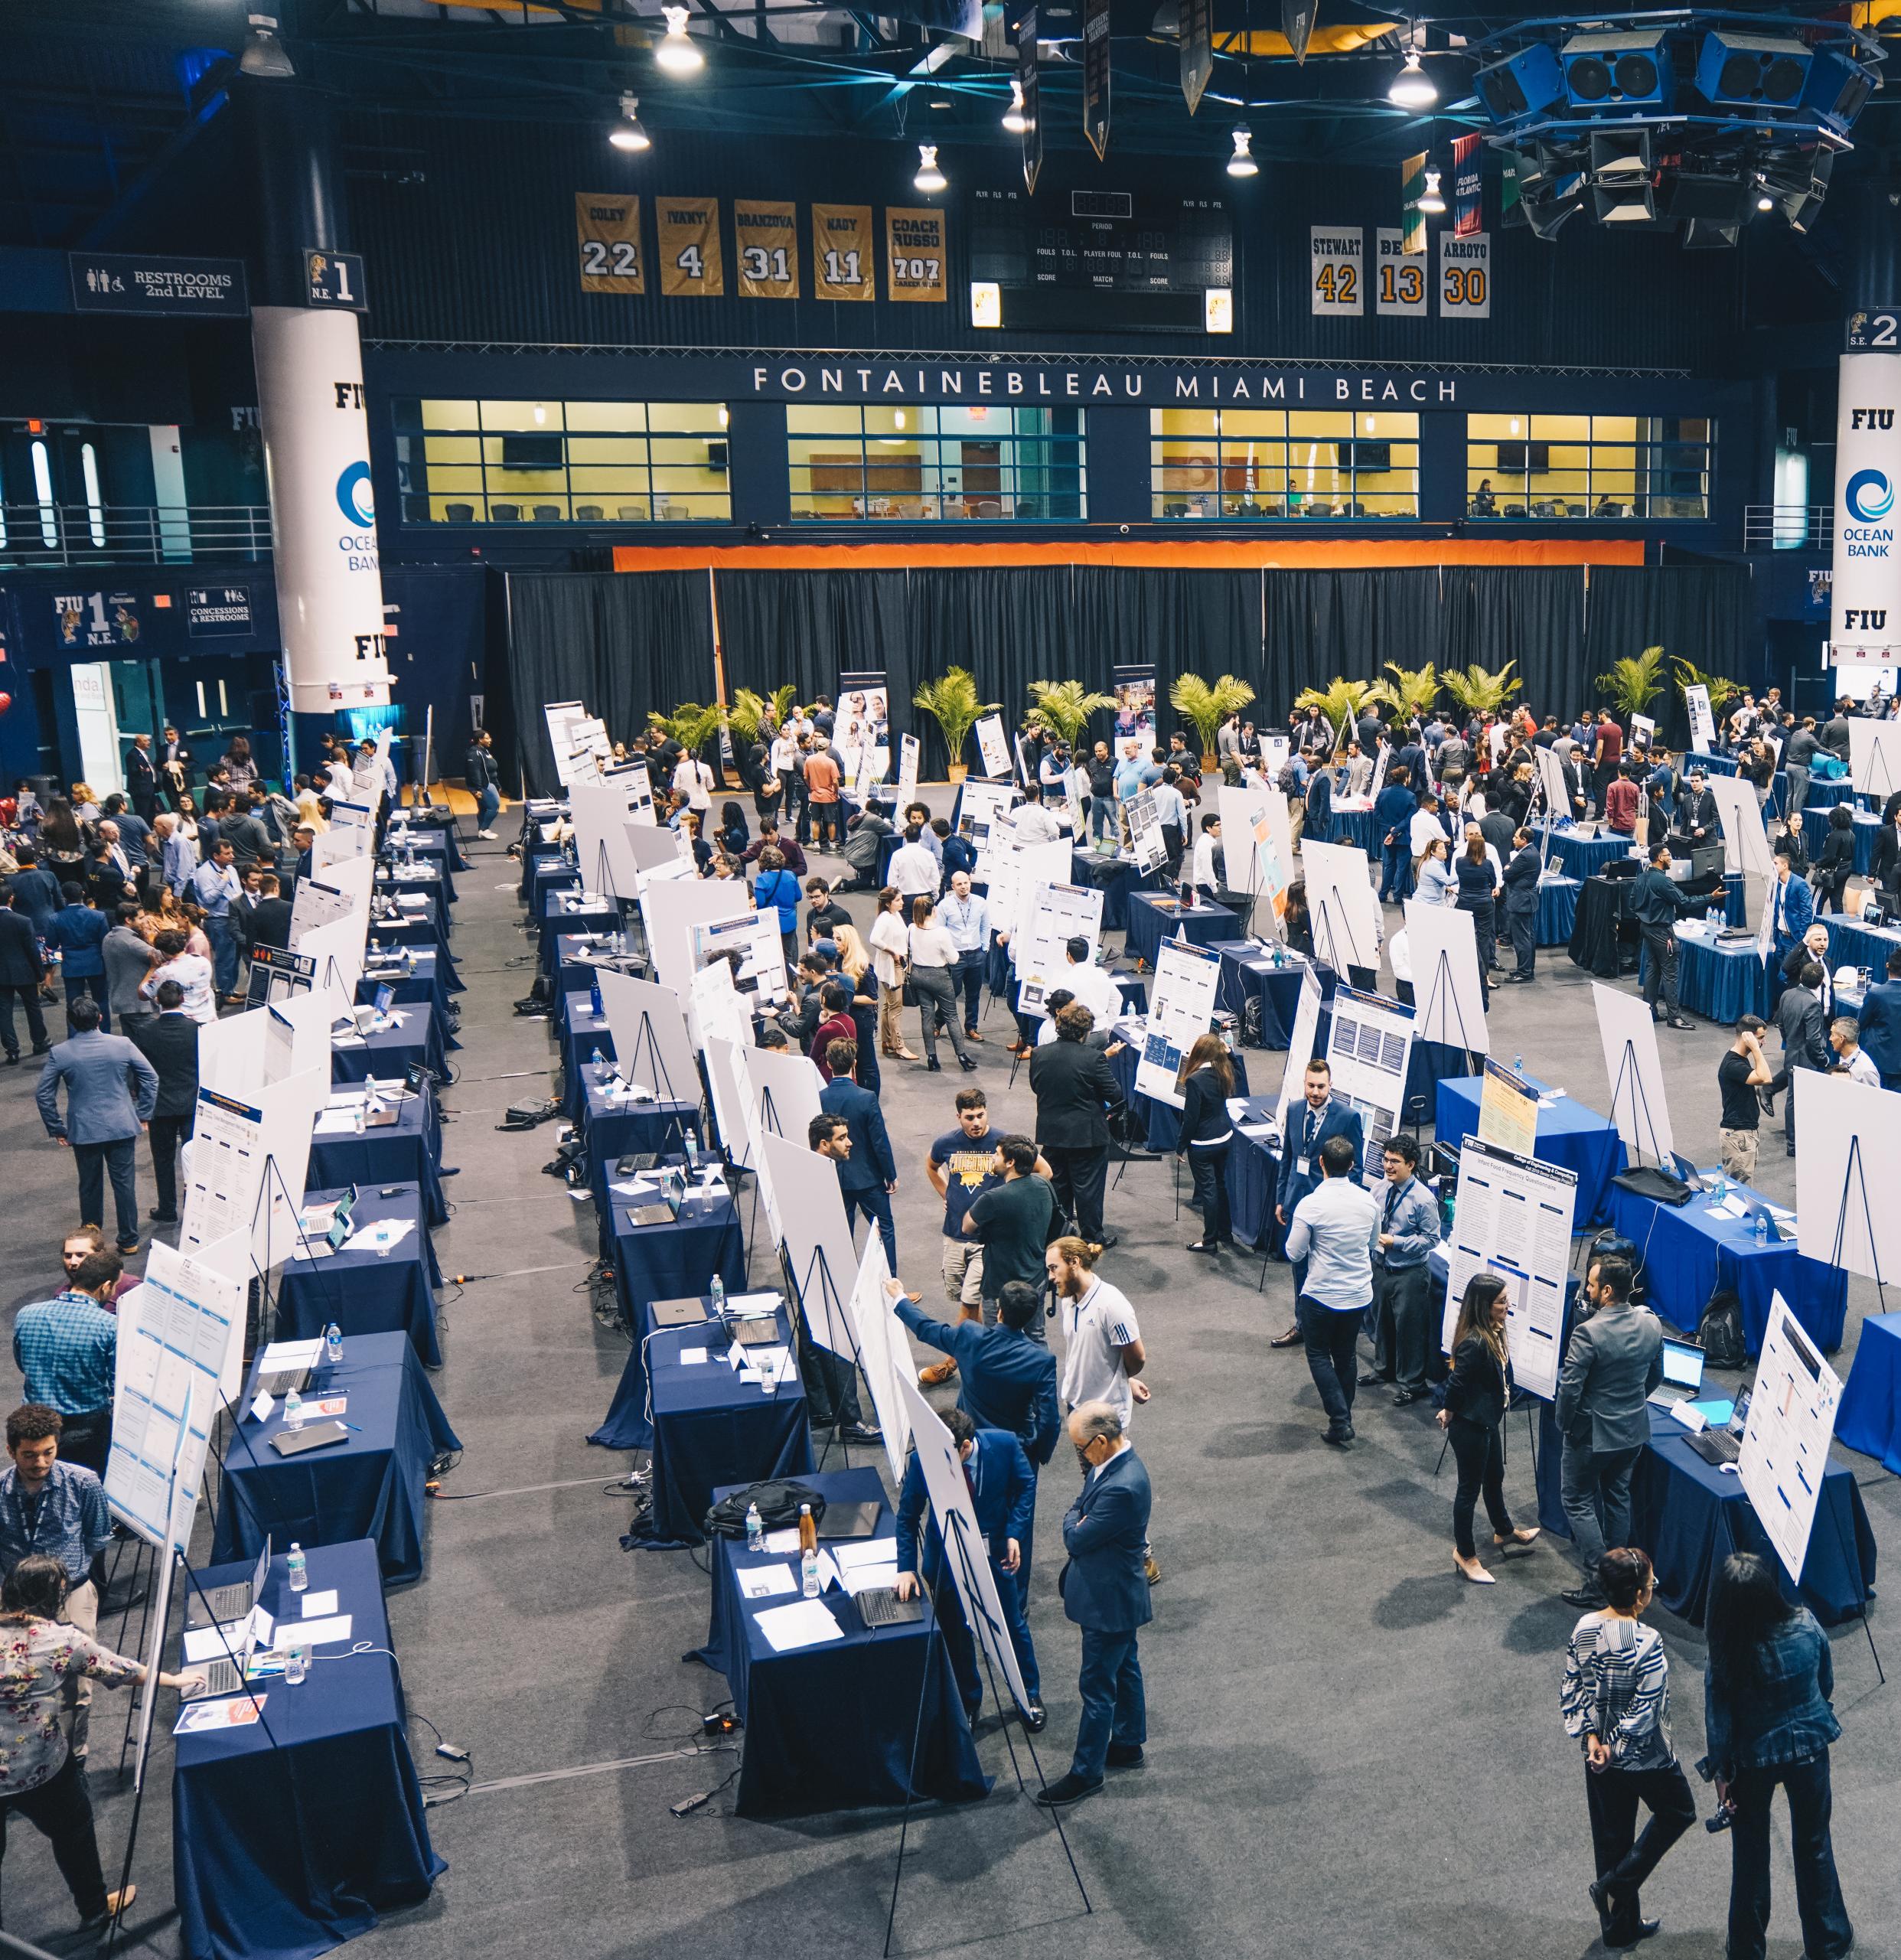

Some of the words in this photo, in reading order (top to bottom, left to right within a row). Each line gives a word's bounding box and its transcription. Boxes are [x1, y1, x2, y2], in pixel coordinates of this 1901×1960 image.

[1457, 173, 1479, 186] FLORIDA
[976, 191, 988, 199] PLYR
[1456, 182, 1482, 196] ATLANTIC
[590, 207, 625, 222] COLEY
[737, 214, 794, 229] BRANZOVA
[827, 218, 858, 231] NAGY
[892, 219, 939, 233] COACH
[892, 233, 940, 248] RUSSO
[1313, 238, 1361, 256] STEWART
[582, 240, 639, 278] 22
[1443, 243, 1486, 259] ARROYO
[677, 244, 705, 279] 4
[743, 246, 791, 282] 31
[824, 249, 862, 285] 11
[894, 257, 941, 280] 707
[134, 271, 232, 287] RESTROOMS
[333, 261, 354, 301] 1
[1316, 263, 1357, 304] 42
[1381, 264, 1424, 305] 13
[1444, 266, 1486, 306] 30
[145, 284, 174, 298] 2nd
[178, 285, 224, 299] LEVEL
[311, 287, 331, 300] N.E.
[1871, 315, 1898, 347] 2
[1850, 336, 1867, 347] S.E.
[754, 367, 1142, 396] FONTAINEBLEAU
[1175, 376, 1303, 399] MIAMI
[1335, 378, 1456, 402] BEACH
[1851, 408, 1895, 431] FIU
[1844, 528, 1893, 542] OCEAN
[339, 536, 378, 552] OCEA
[1847, 544, 1889, 557] BANK
[54, 595, 84, 615] FIU
[88, 592, 109, 632] 1
[191, 606, 249, 616] CONCESSIONS
[200, 613, 250, 623] RESTROOMS
[1844, 609, 1887, 631] FIU
[87, 632, 116, 646] N.E.
[1477, 1158, 1490, 1168] Infant
[1490, 1163, 1502, 1172] Food
[1502, 1166, 1524, 1180] Frequency
[1525, 1175, 1557, 1192] Questionnaire
[1513, 1155, 1527, 1164] College
[1530, 1159, 1551, 1173] Engineering
[1554, 1169, 1574, 1182] Computing
